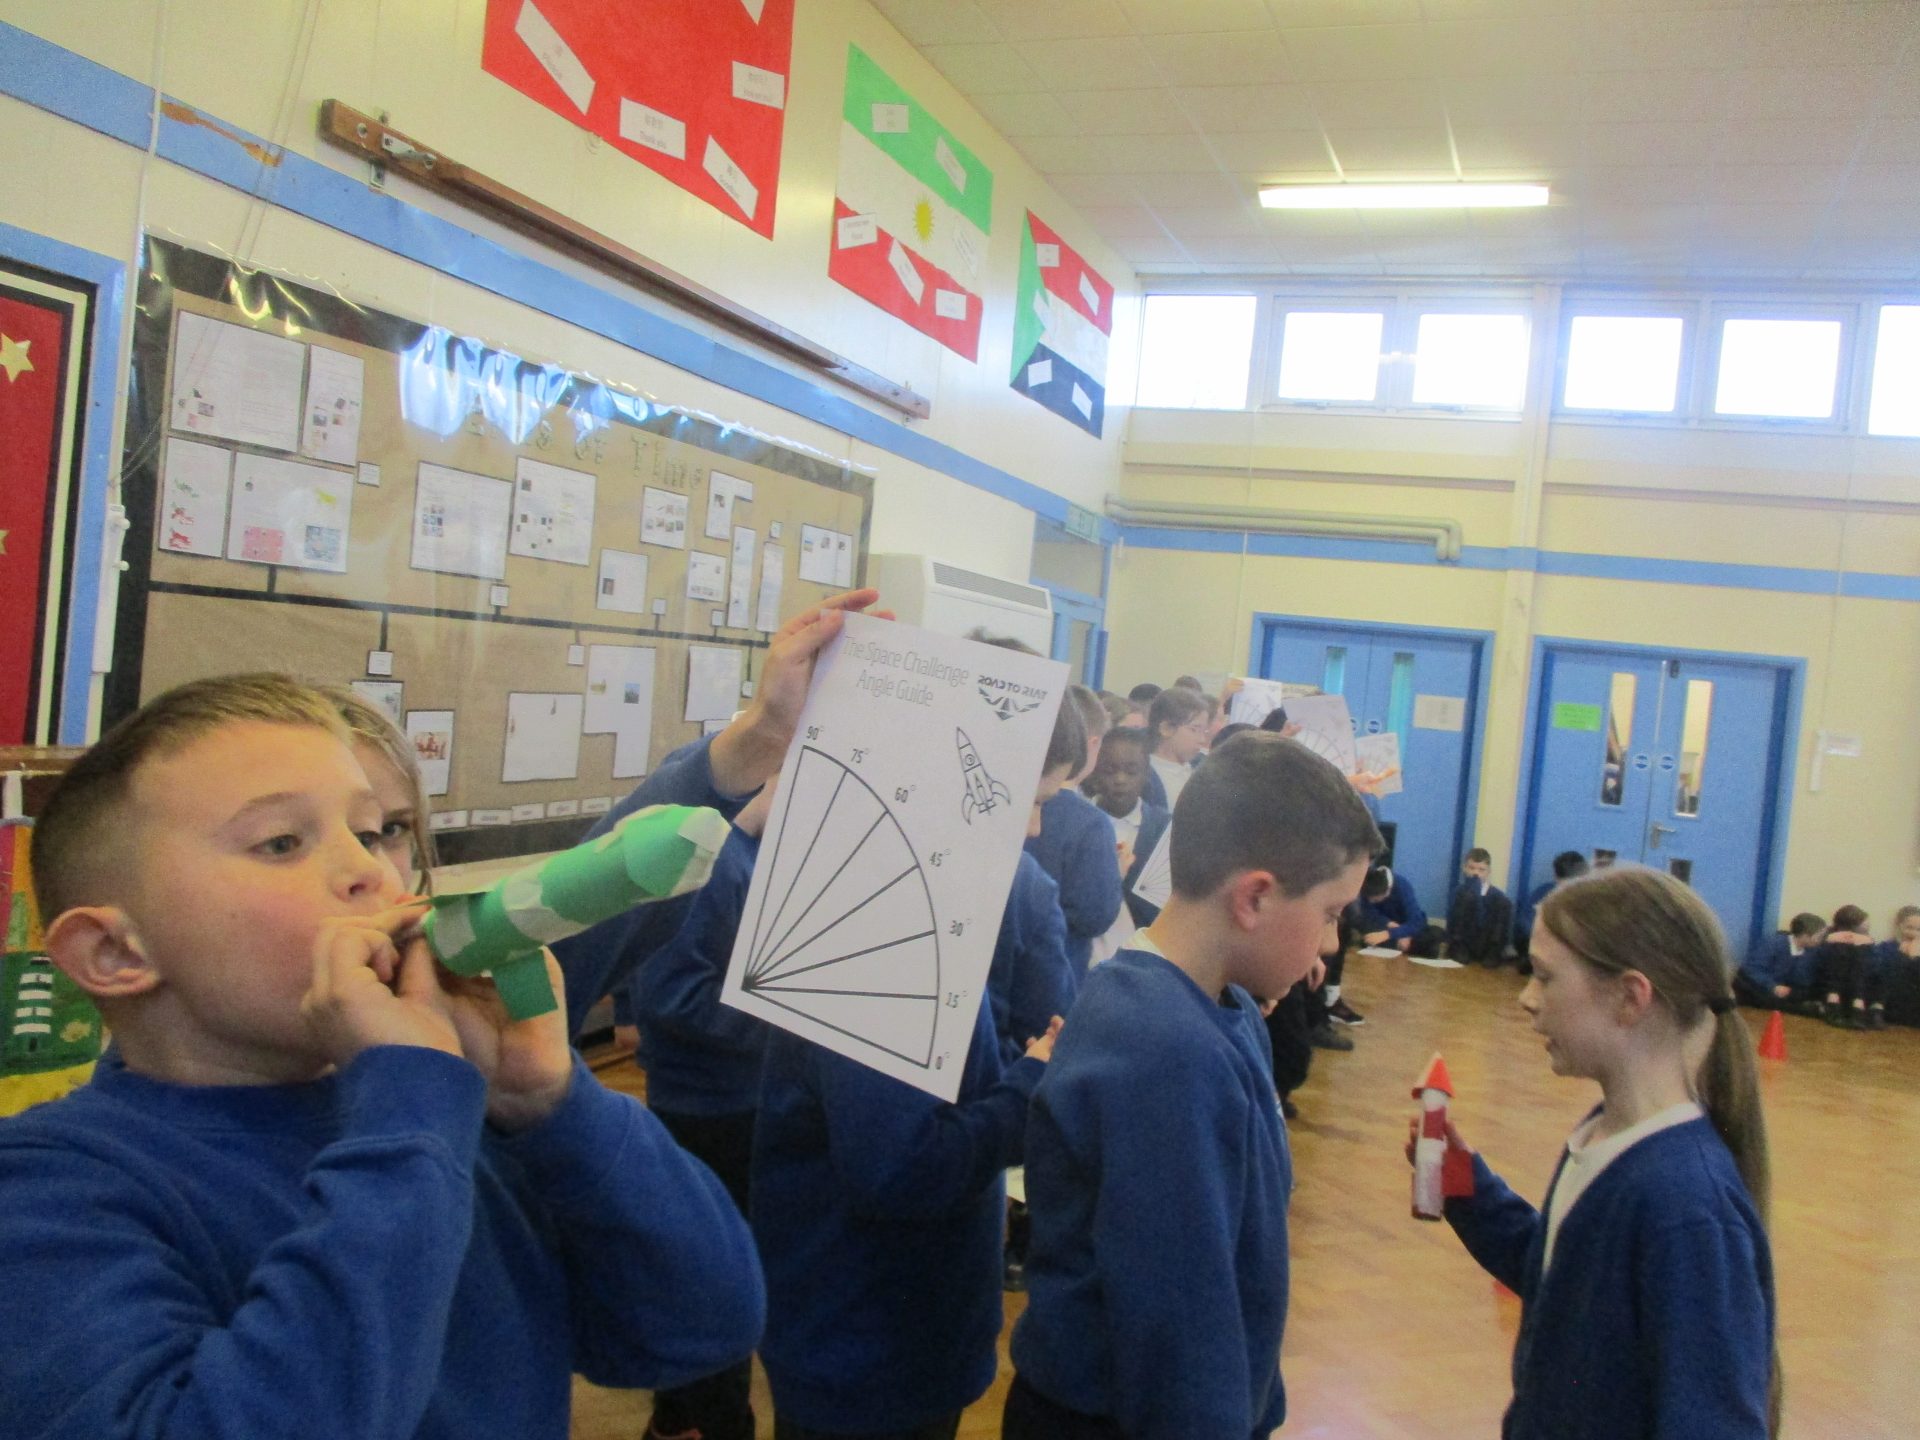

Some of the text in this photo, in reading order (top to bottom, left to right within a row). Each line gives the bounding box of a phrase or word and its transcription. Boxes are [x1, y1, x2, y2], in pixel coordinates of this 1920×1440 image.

[843, 635, 969, 688] The Space Challenge
[856, 669, 934, 708] Angle Guide
[1007, 682, 1021, 694] TO
